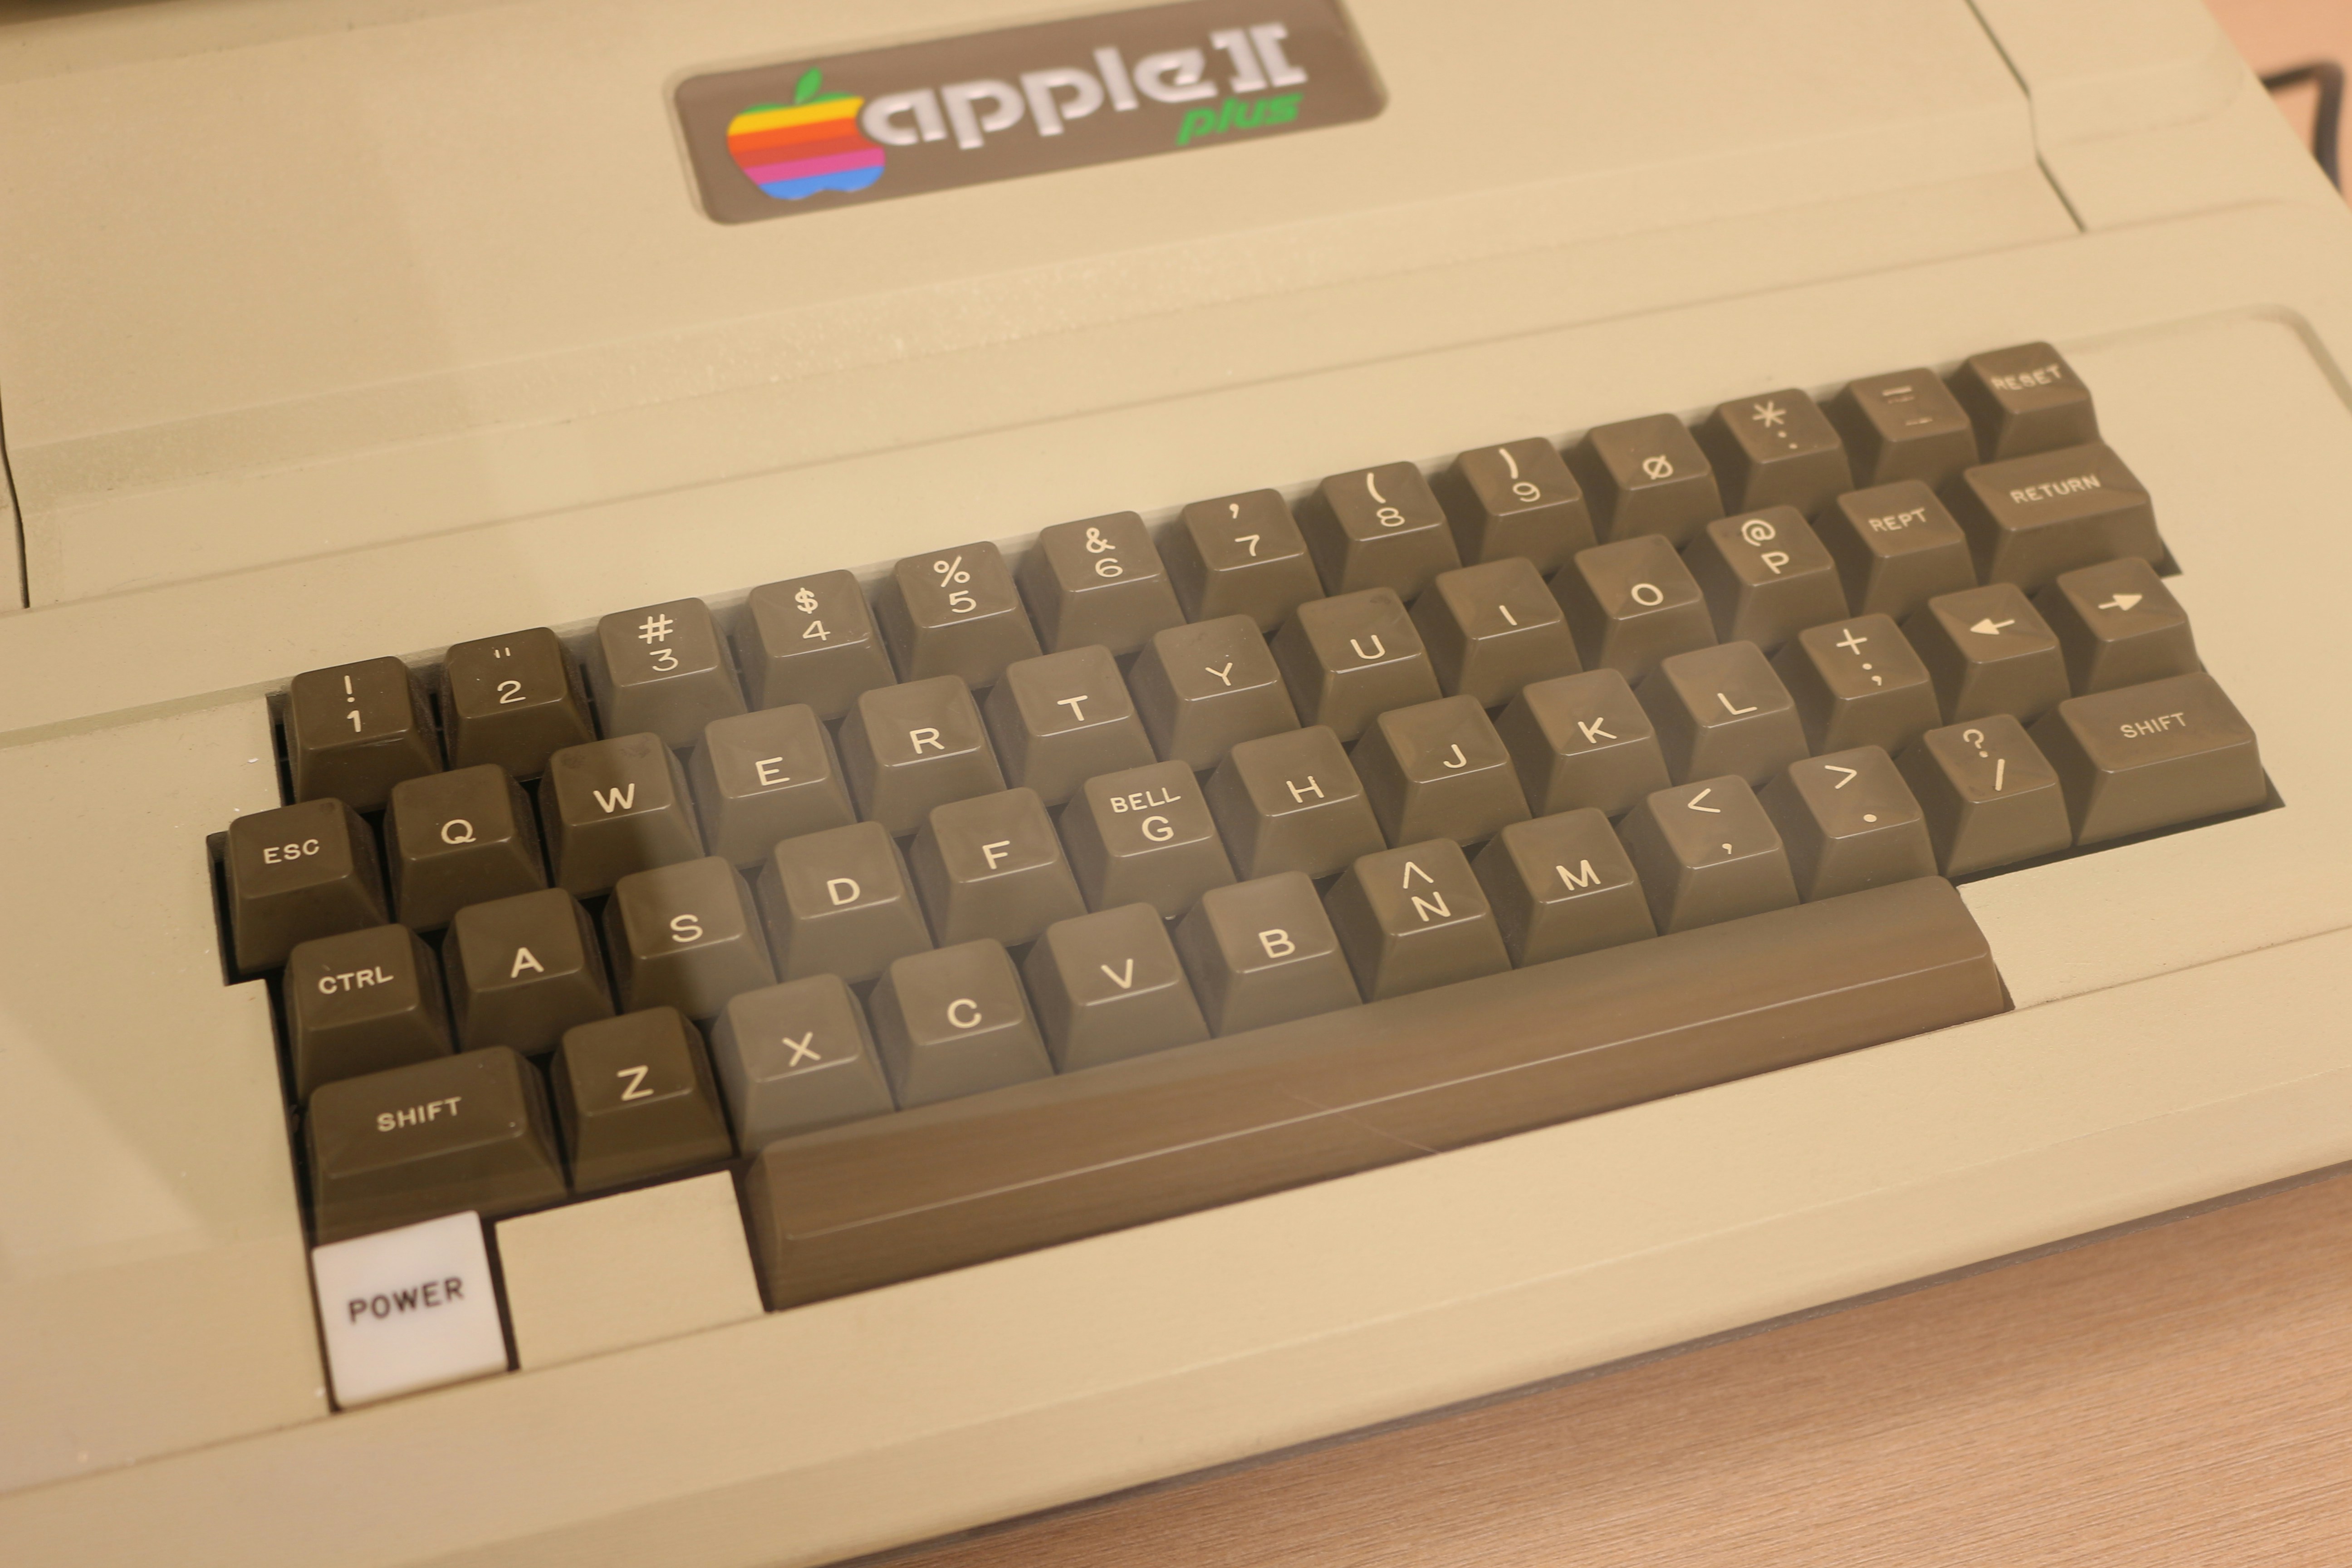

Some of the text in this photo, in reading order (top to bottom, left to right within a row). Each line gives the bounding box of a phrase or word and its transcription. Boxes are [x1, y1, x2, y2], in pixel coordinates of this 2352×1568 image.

[862, 46, 1217, 150] apple
[1176, 92, 1303, 147] plus
[1991, 363, 2063, 390] RESET
[1499, 448, 1519, 479] )
[1367, 472, 1386, 504] (
[1512, 482, 1540, 502] 9
[2010, 475, 2101, 504] RETURN
[1376, 507, 1405, 527] 8
[1868, 508, 1926, 532] REPT
[1086, 527, 1116, 554] &
[1235, 534, 1260, 557] 7
[1741, 519, 1776, 547] @
[933, 556, 970, 588] %
[1095, 558, 1124, 578] 6
[1761, 551, 1789, 574] P
[794, 587, 818, 614] $
[949, 590, 976, 613] 5
[1631, 583, 1663, 606] O
[638, 613, 673, 644] #
[1499, 605, 1517, 626] I
[802, 620, 831, 641] 4
[1836, 628, 1867, 655] +
[1350, 634, 1385, 659] U
[649, 649, 679, 673] 3
[1205, 662, 1233, 686] Y
[1862, 663, 1882, 686] ;
[344, 675, 355, 702] !
[497, 680, 526, 704] 2
[1057, 695, 1088, 721] T
[1717, 693, 1758, 715] L
[347, 710, 361, 732] 1
[1578, 717, 1617, 744] K
[2120, 712, 2185, 738] SHIFT
[909, 727, 946, 755] R
[1963, 729, 1988, 758] ?
[1443, 744, 1467, 768] J
[755, 757, 790, 786] E
[1825, 765, 1857, 789] >
[593, 783, 635, 813] W
[1110, 787, 1182, 814] BELL
[1286, 775, 1325, 804] H
[1687, 788, 1721, 813] <
[441, 819, 476, 844] Q
[1142, 816, 1174, 842] G
[1863, 814, 1877, 823] .
[264, 839, 319, 864] ESC
[982, 840, 1011, 870] F
[1556, 859, 1602, 891] M
[827, 878, 860, 905] D
[1411, 891, 1451, 922] N
[670, 914, 703, 942] S
[1259, 929, 1295, 958] B
[511, 947, 543, 978] A
[1101, 958, 1133, 989] V
[318, 966, 394, 994] CTRL
[947, 999, 981, 1028] C
[782, 1032, 822, 1068] X
[617, 1065, 653, 1100] Z
[377, 1097, 461, 1132] SHIFT
[347, 1275, 464, 1325] POWER
